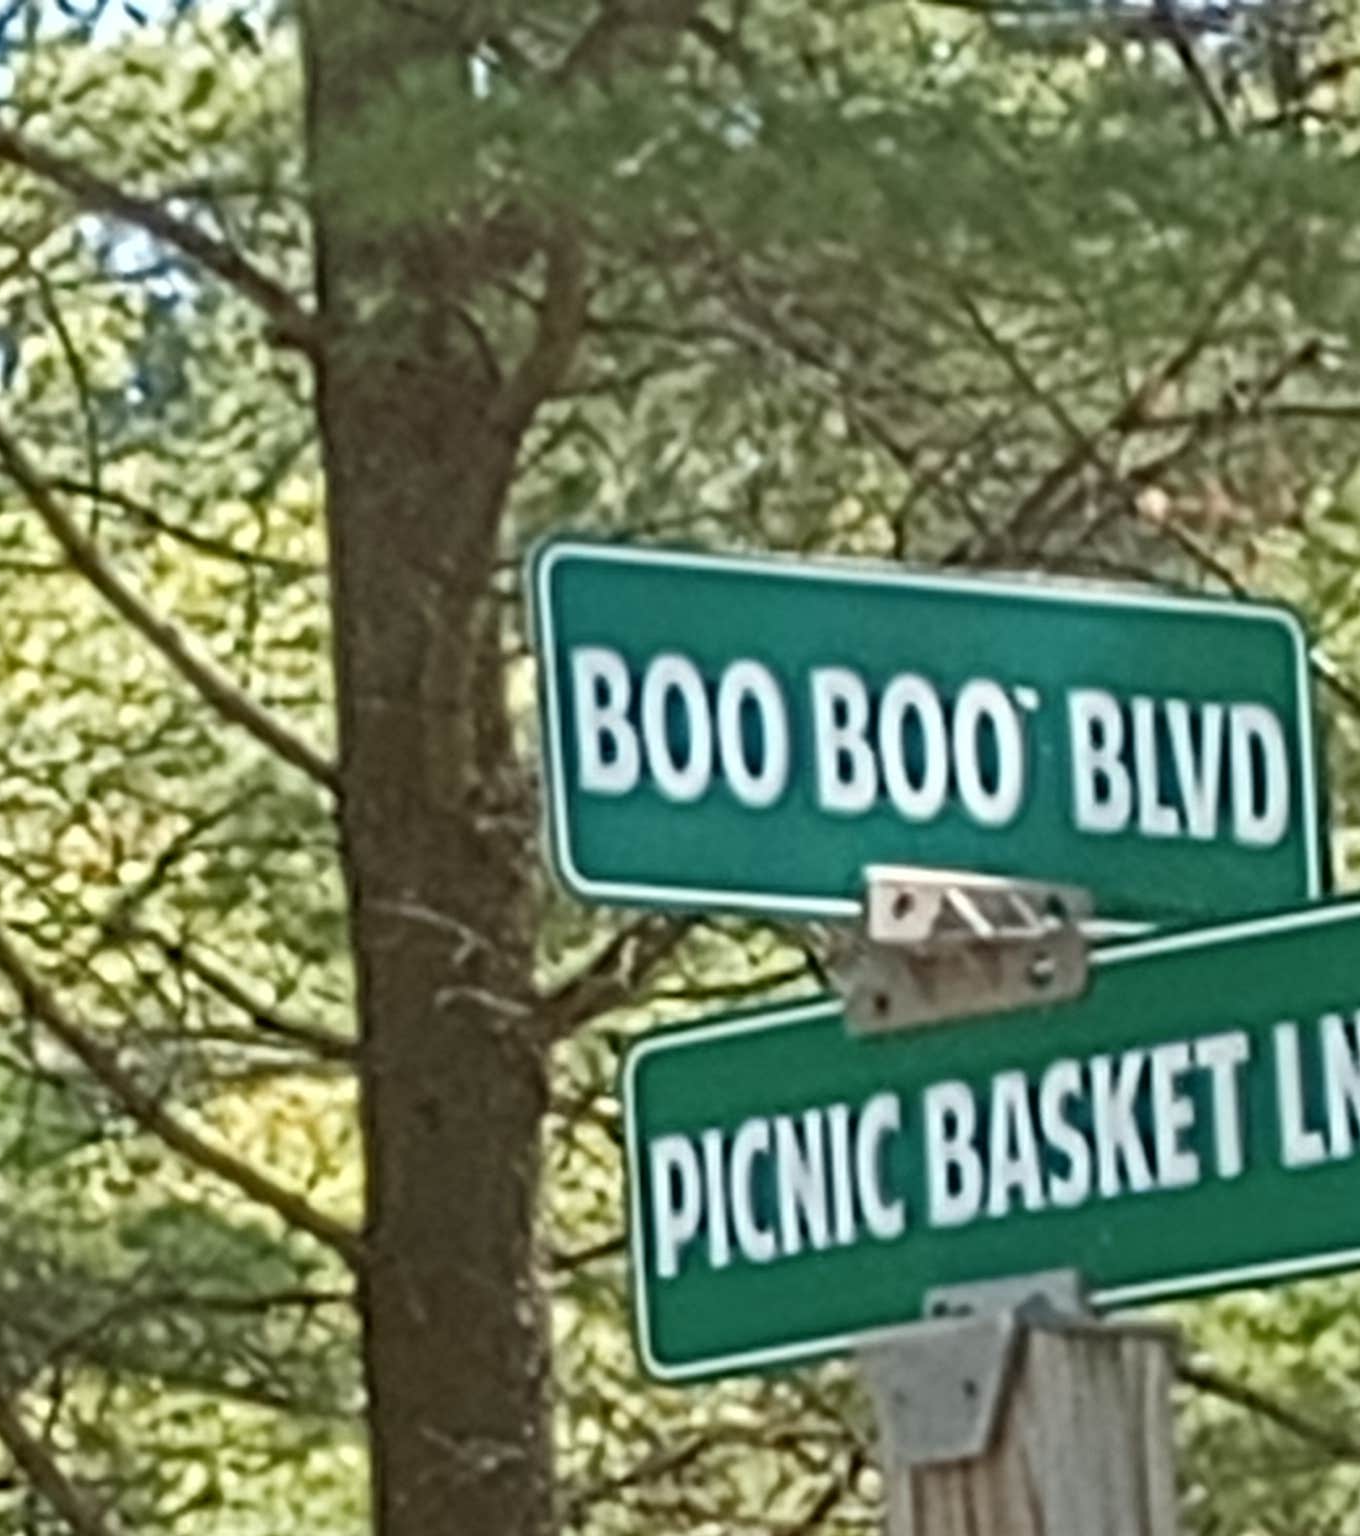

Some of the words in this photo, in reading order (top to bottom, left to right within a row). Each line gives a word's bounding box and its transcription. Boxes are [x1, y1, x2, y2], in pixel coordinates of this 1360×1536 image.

[571, 646, 790, 807] BOO
[1067, 688, 1290, 846] BLVD
[649, 1093, 904, 1279] PICNIC
[922, 1030, 1250, 1227] BASKET
